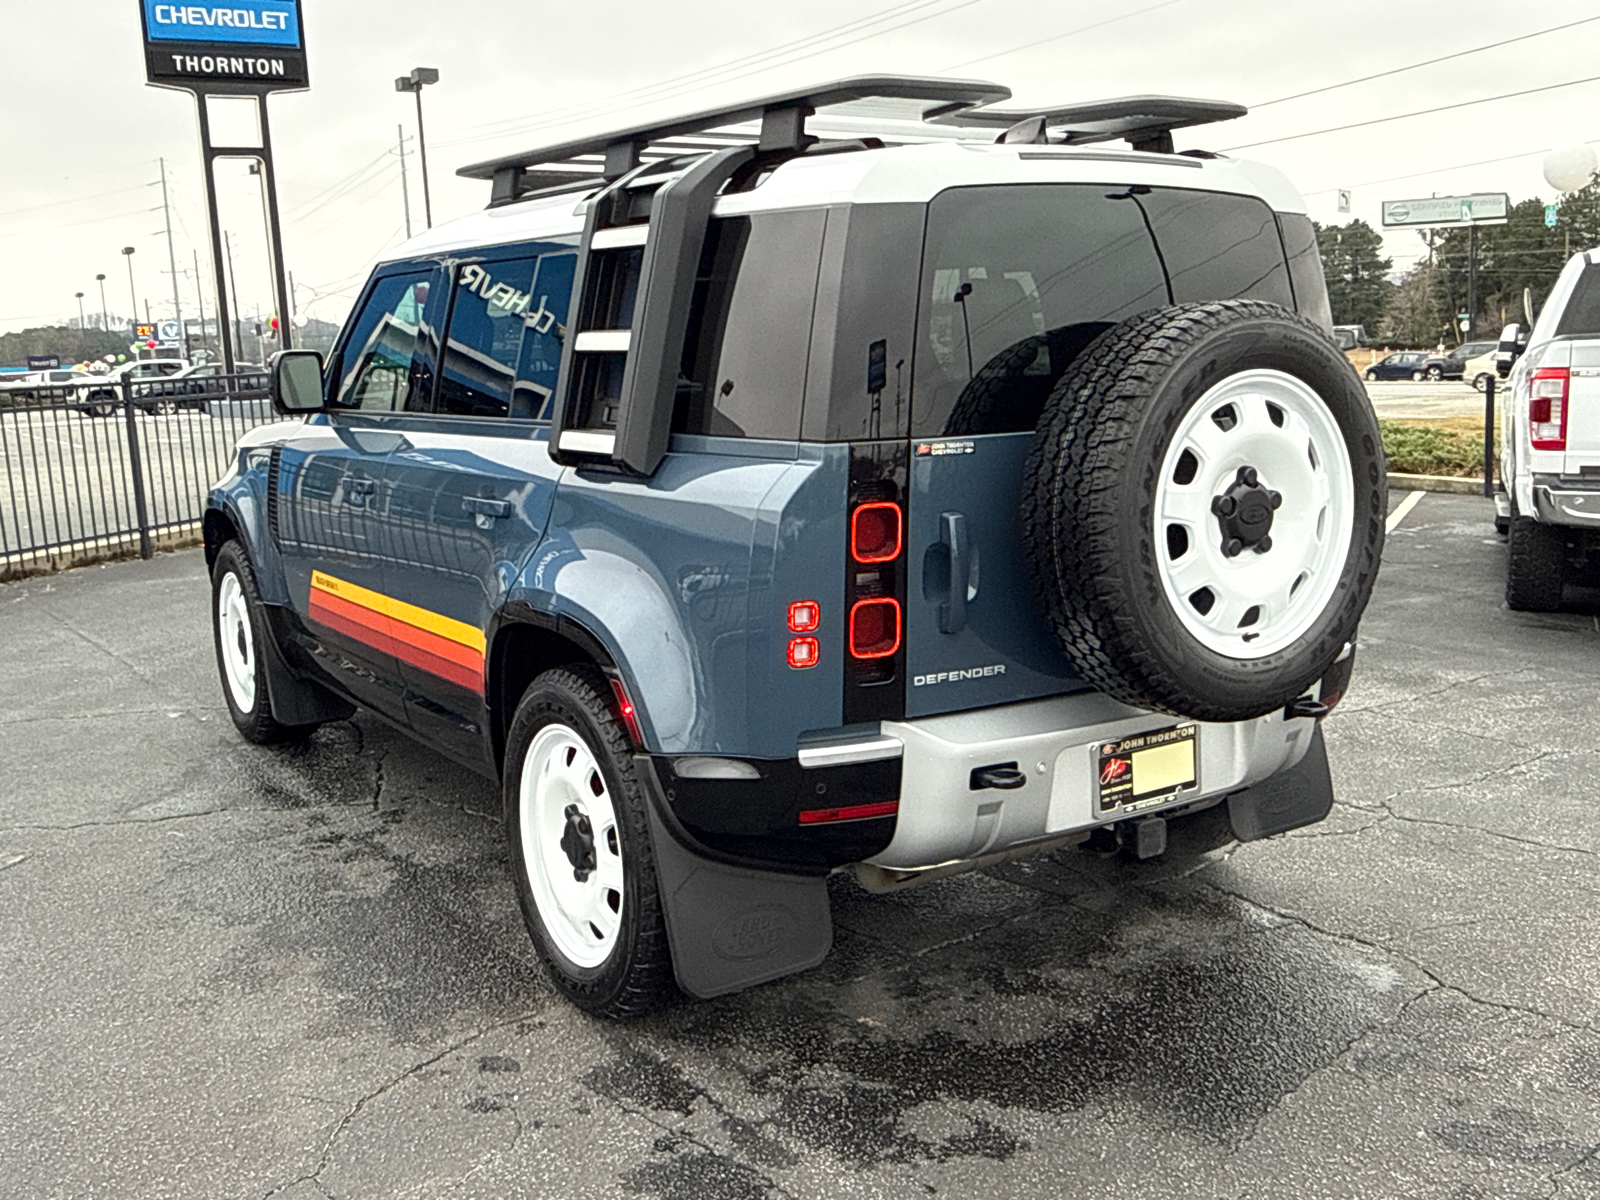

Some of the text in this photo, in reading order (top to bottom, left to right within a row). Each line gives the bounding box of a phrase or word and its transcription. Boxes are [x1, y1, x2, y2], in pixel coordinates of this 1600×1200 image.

[155, 5, 289, 30] CHEVROLET
[172, 55, 285, 76] THORNTON
[913, 664, 1007, 687] DEFENDER
[1119, 738, 1144, 751] JOHN
